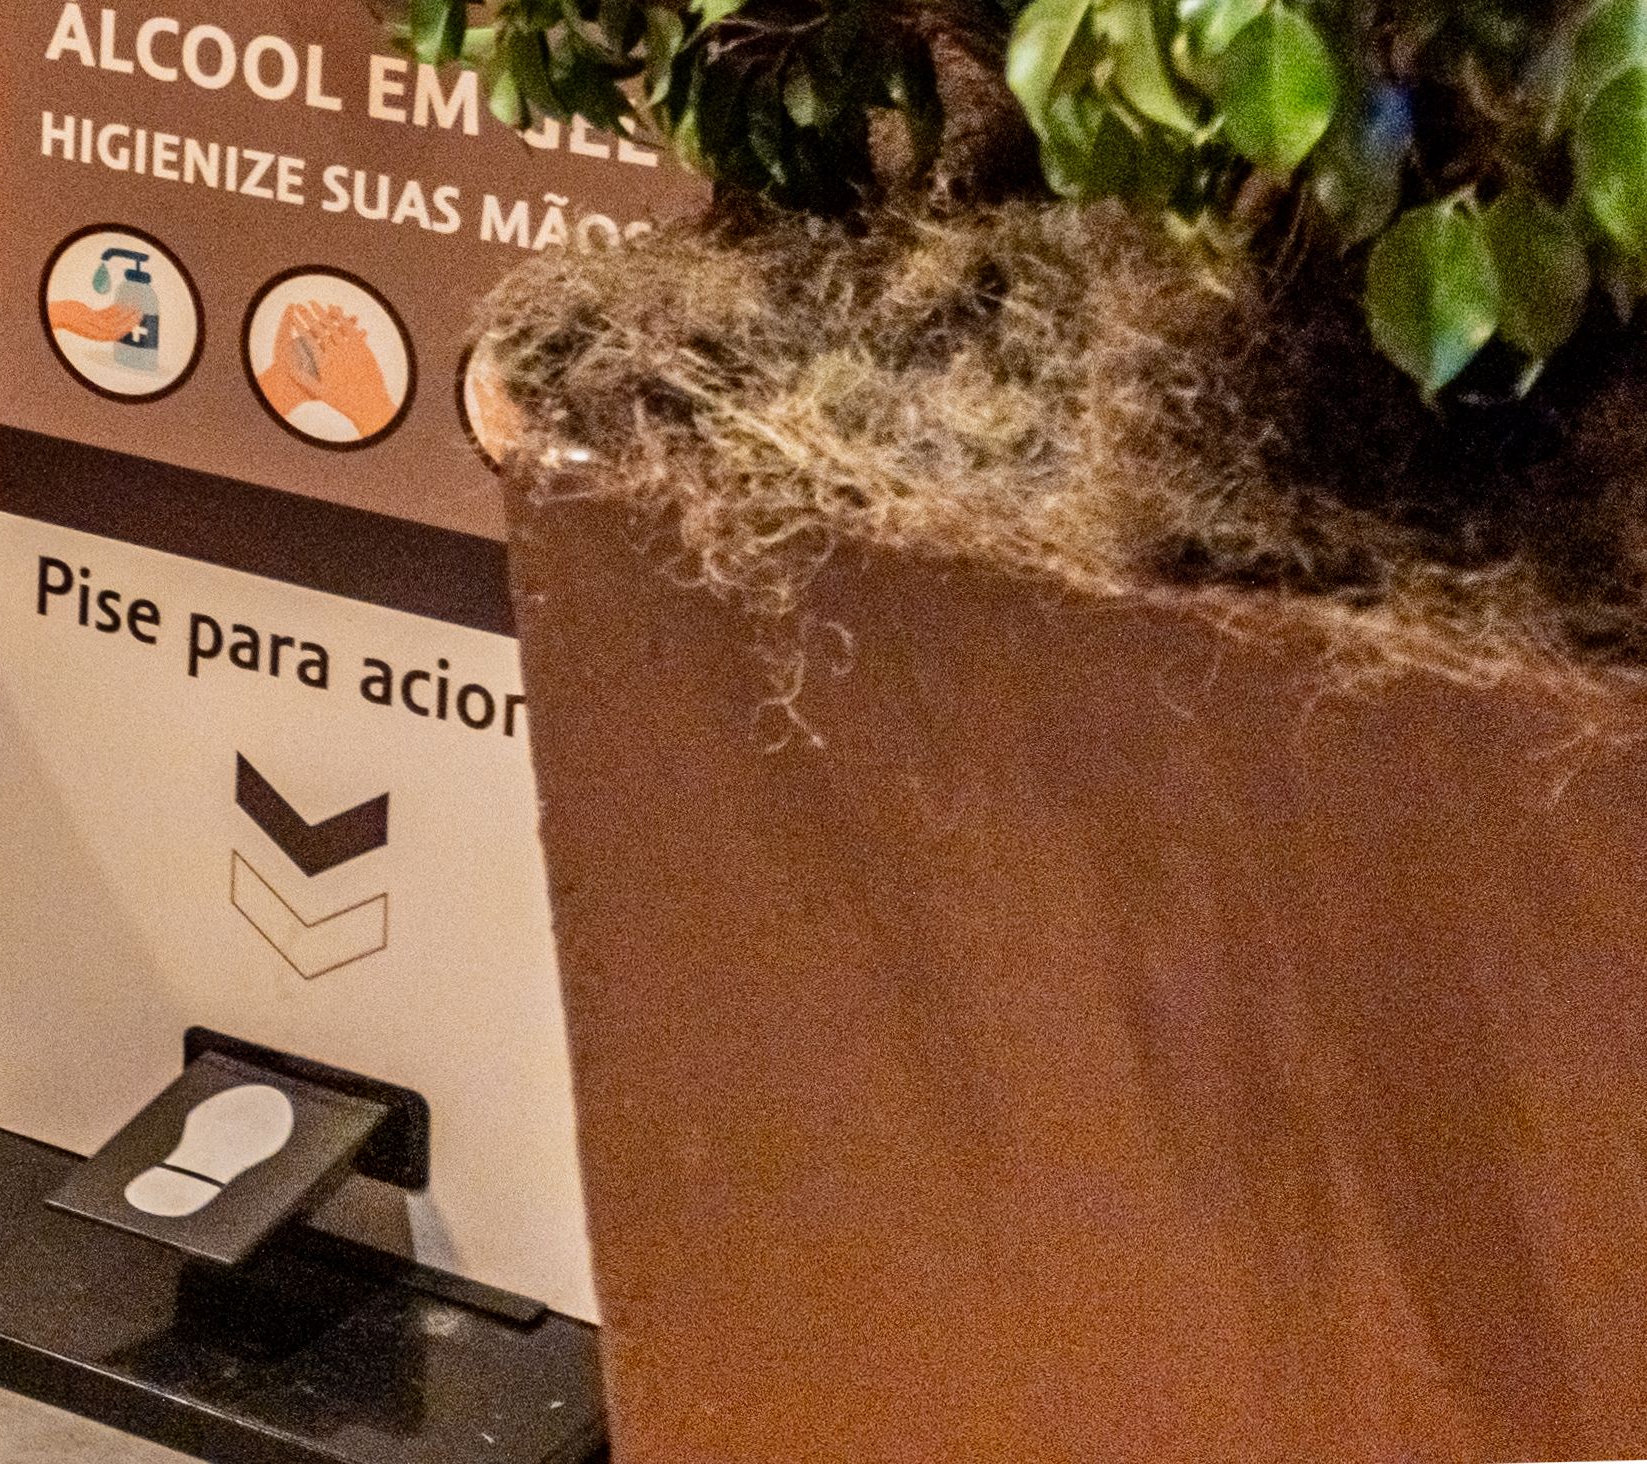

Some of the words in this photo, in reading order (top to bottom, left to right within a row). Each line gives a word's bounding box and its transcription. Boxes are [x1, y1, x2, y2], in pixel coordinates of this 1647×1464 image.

[368, 54, 479, 137] EM
[41, 110, 306, 206] HIGIENIZE
[321, 164, 461, 235] SUAS
[36, 555, 161, 645] Pise
[187, 612, 330, 690] para
